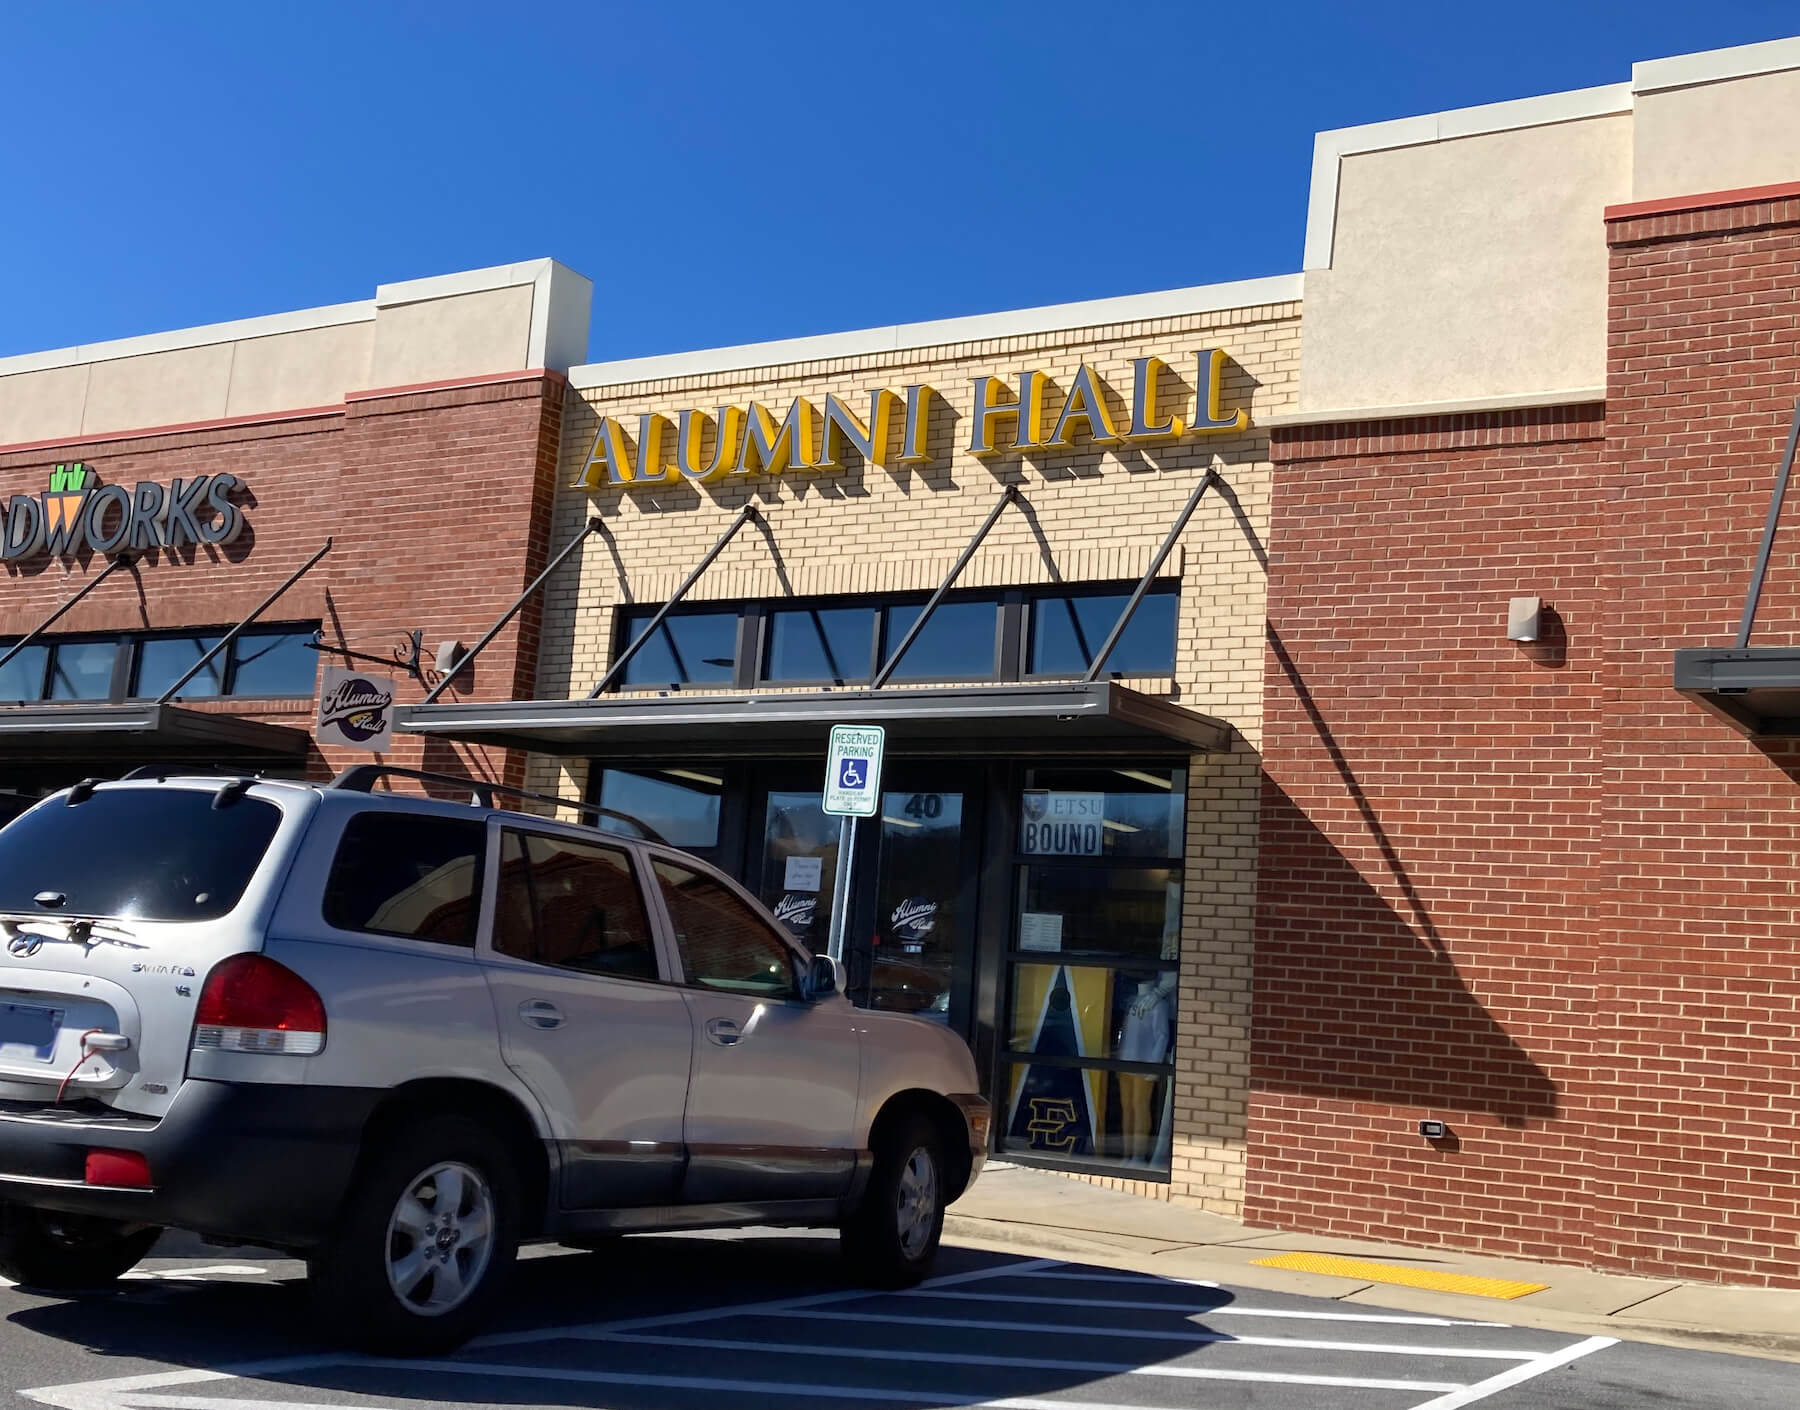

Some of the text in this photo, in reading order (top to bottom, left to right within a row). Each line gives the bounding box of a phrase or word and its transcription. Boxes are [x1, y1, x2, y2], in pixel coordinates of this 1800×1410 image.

[570, 347, 1249, 492] ALUMNI HALL
[0, 463, 244, 560] DWORKS
[322, 679, 392, 715] Alumni
[352, 714, 386, 734] Hall
[834, 732, 879, 745] RESERVED
[837, 746, 874, 757] PARKING
[904, 794, 943, 818] 40
[1054, 798, 1102, 816] ETSU
[1025, 822, 1098, 855] BOUND
[774, 894, 817, 917] Alumni
[891, 898, 937, 923] Alumni
